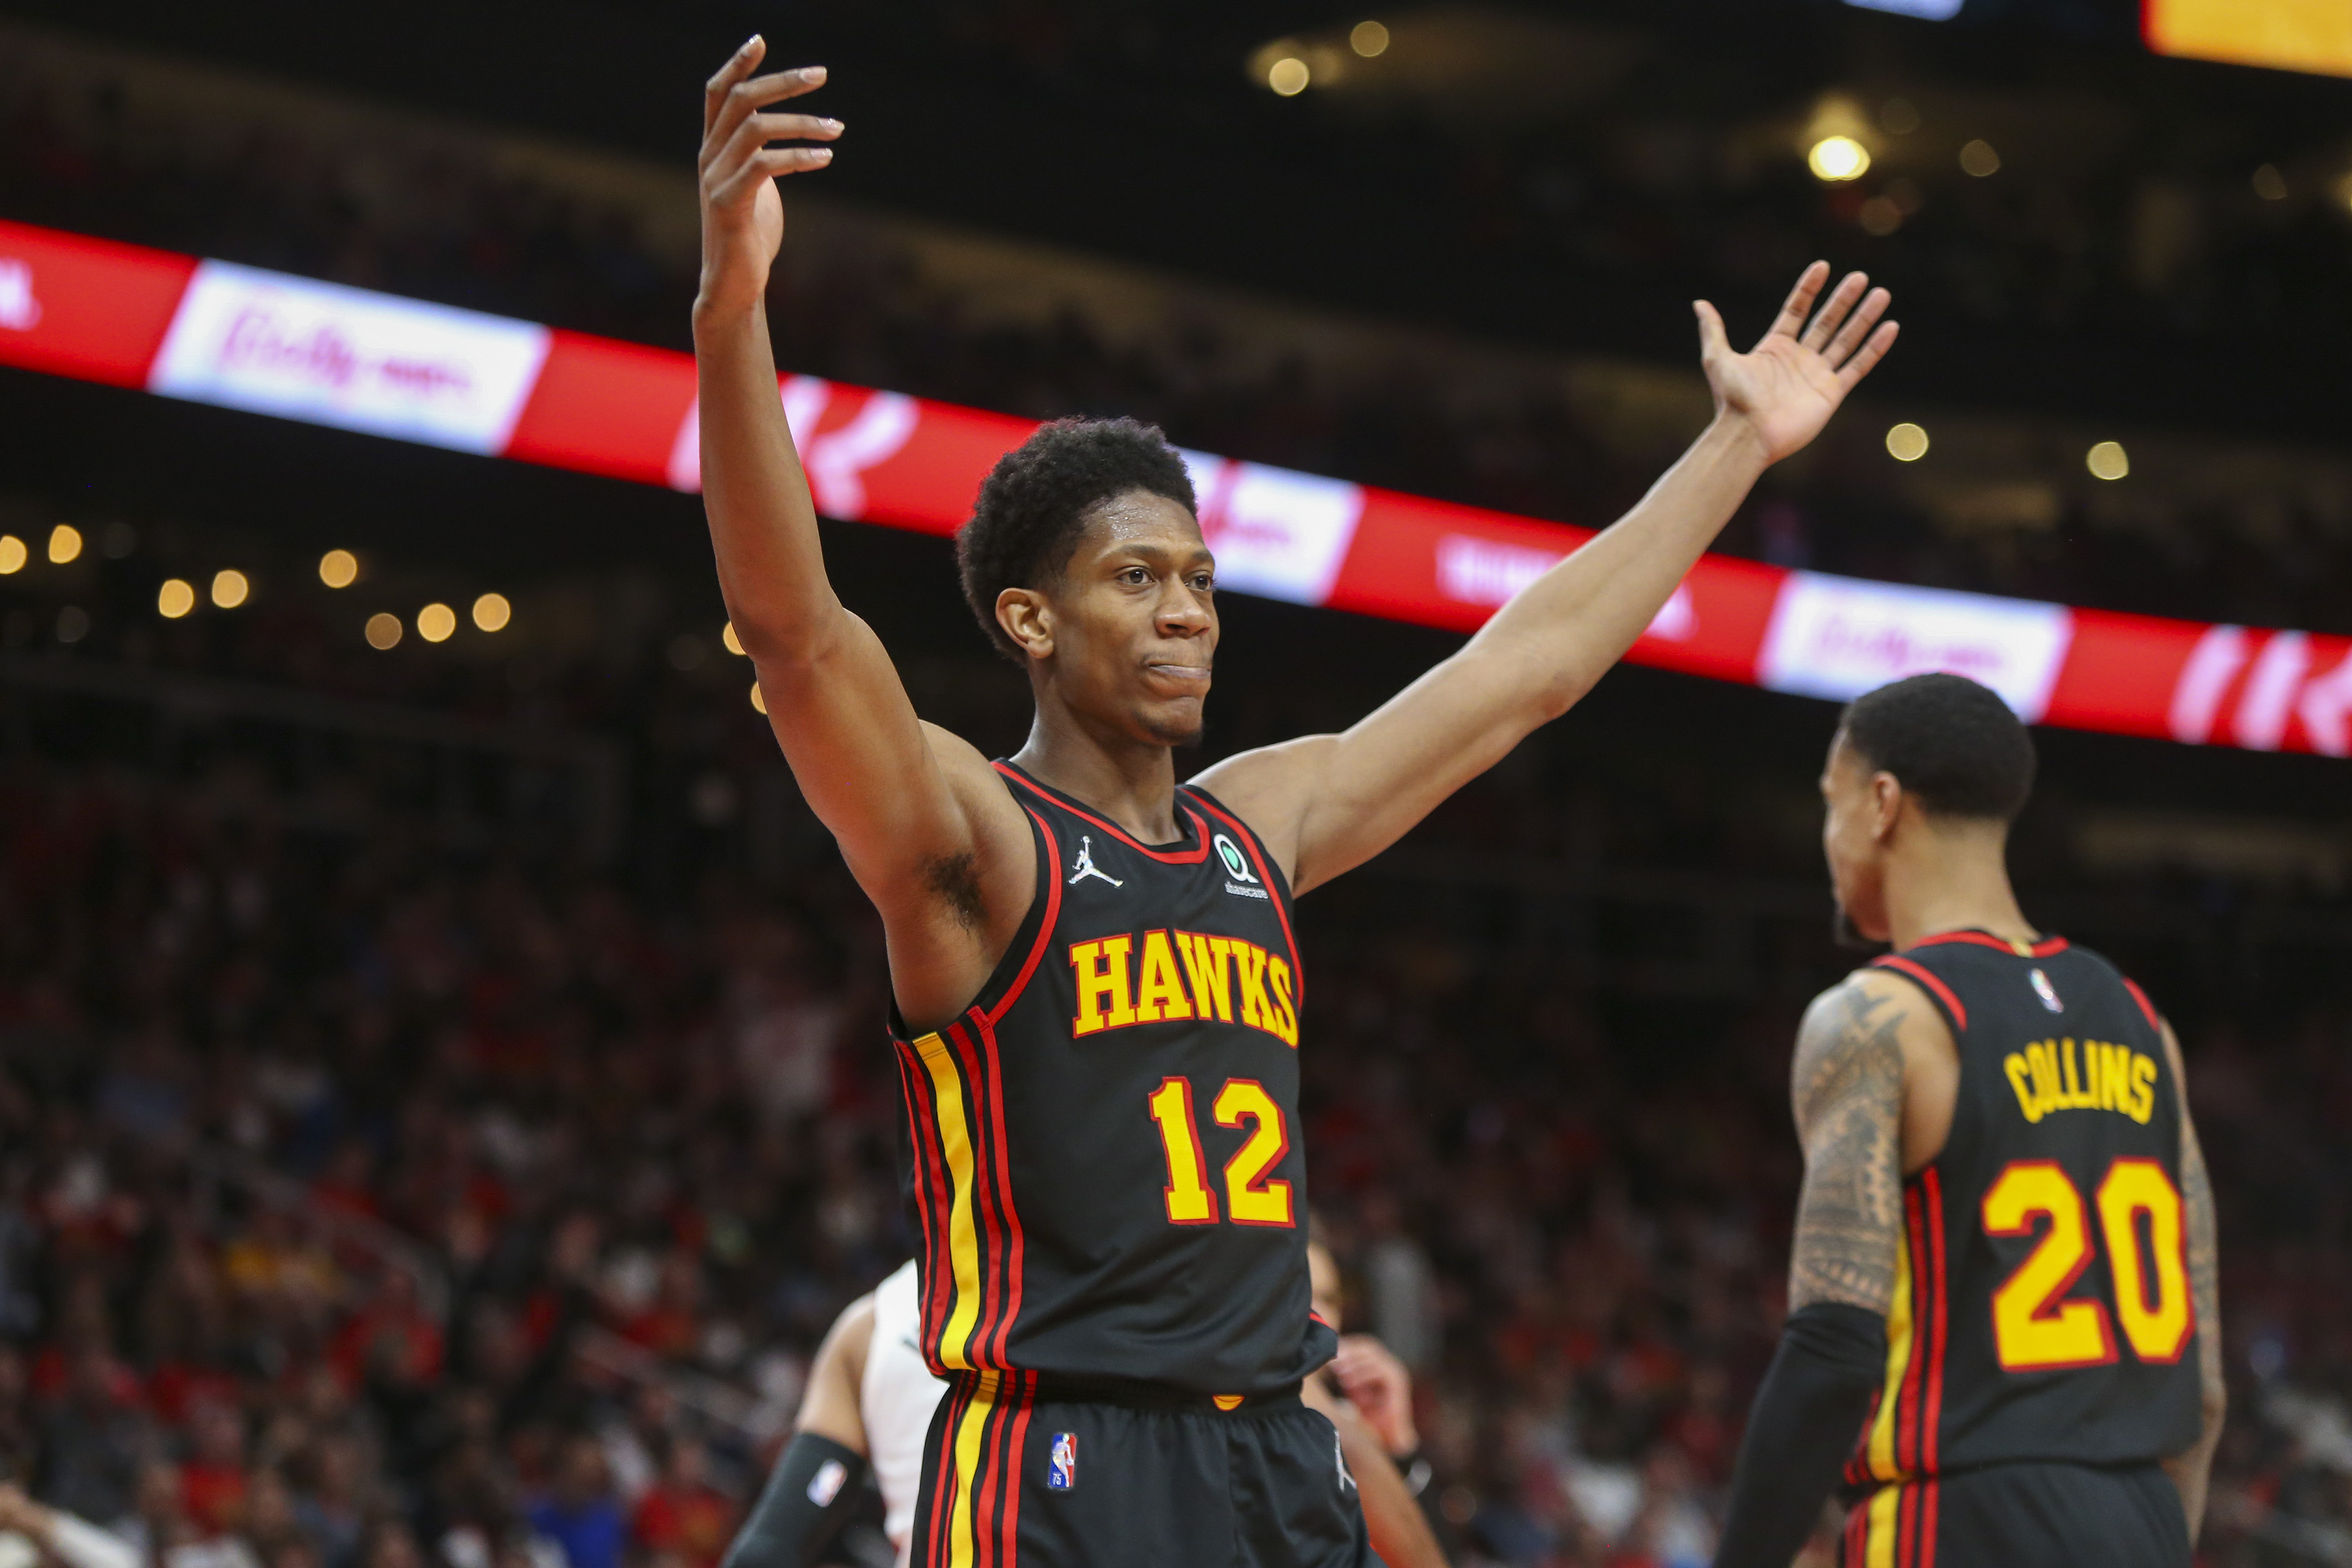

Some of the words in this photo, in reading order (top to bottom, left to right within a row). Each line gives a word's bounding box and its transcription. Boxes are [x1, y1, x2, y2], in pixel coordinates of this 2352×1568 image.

[1069, 929, 1299, 1049] HAWKS
[2003, 1037, 2157, 1125] COLLINS
[1149, 1076, 1296, 1228] 12
[1981, 1157, 2195, 1372] 20
[1053, 1473, 1062, 1485] 75
